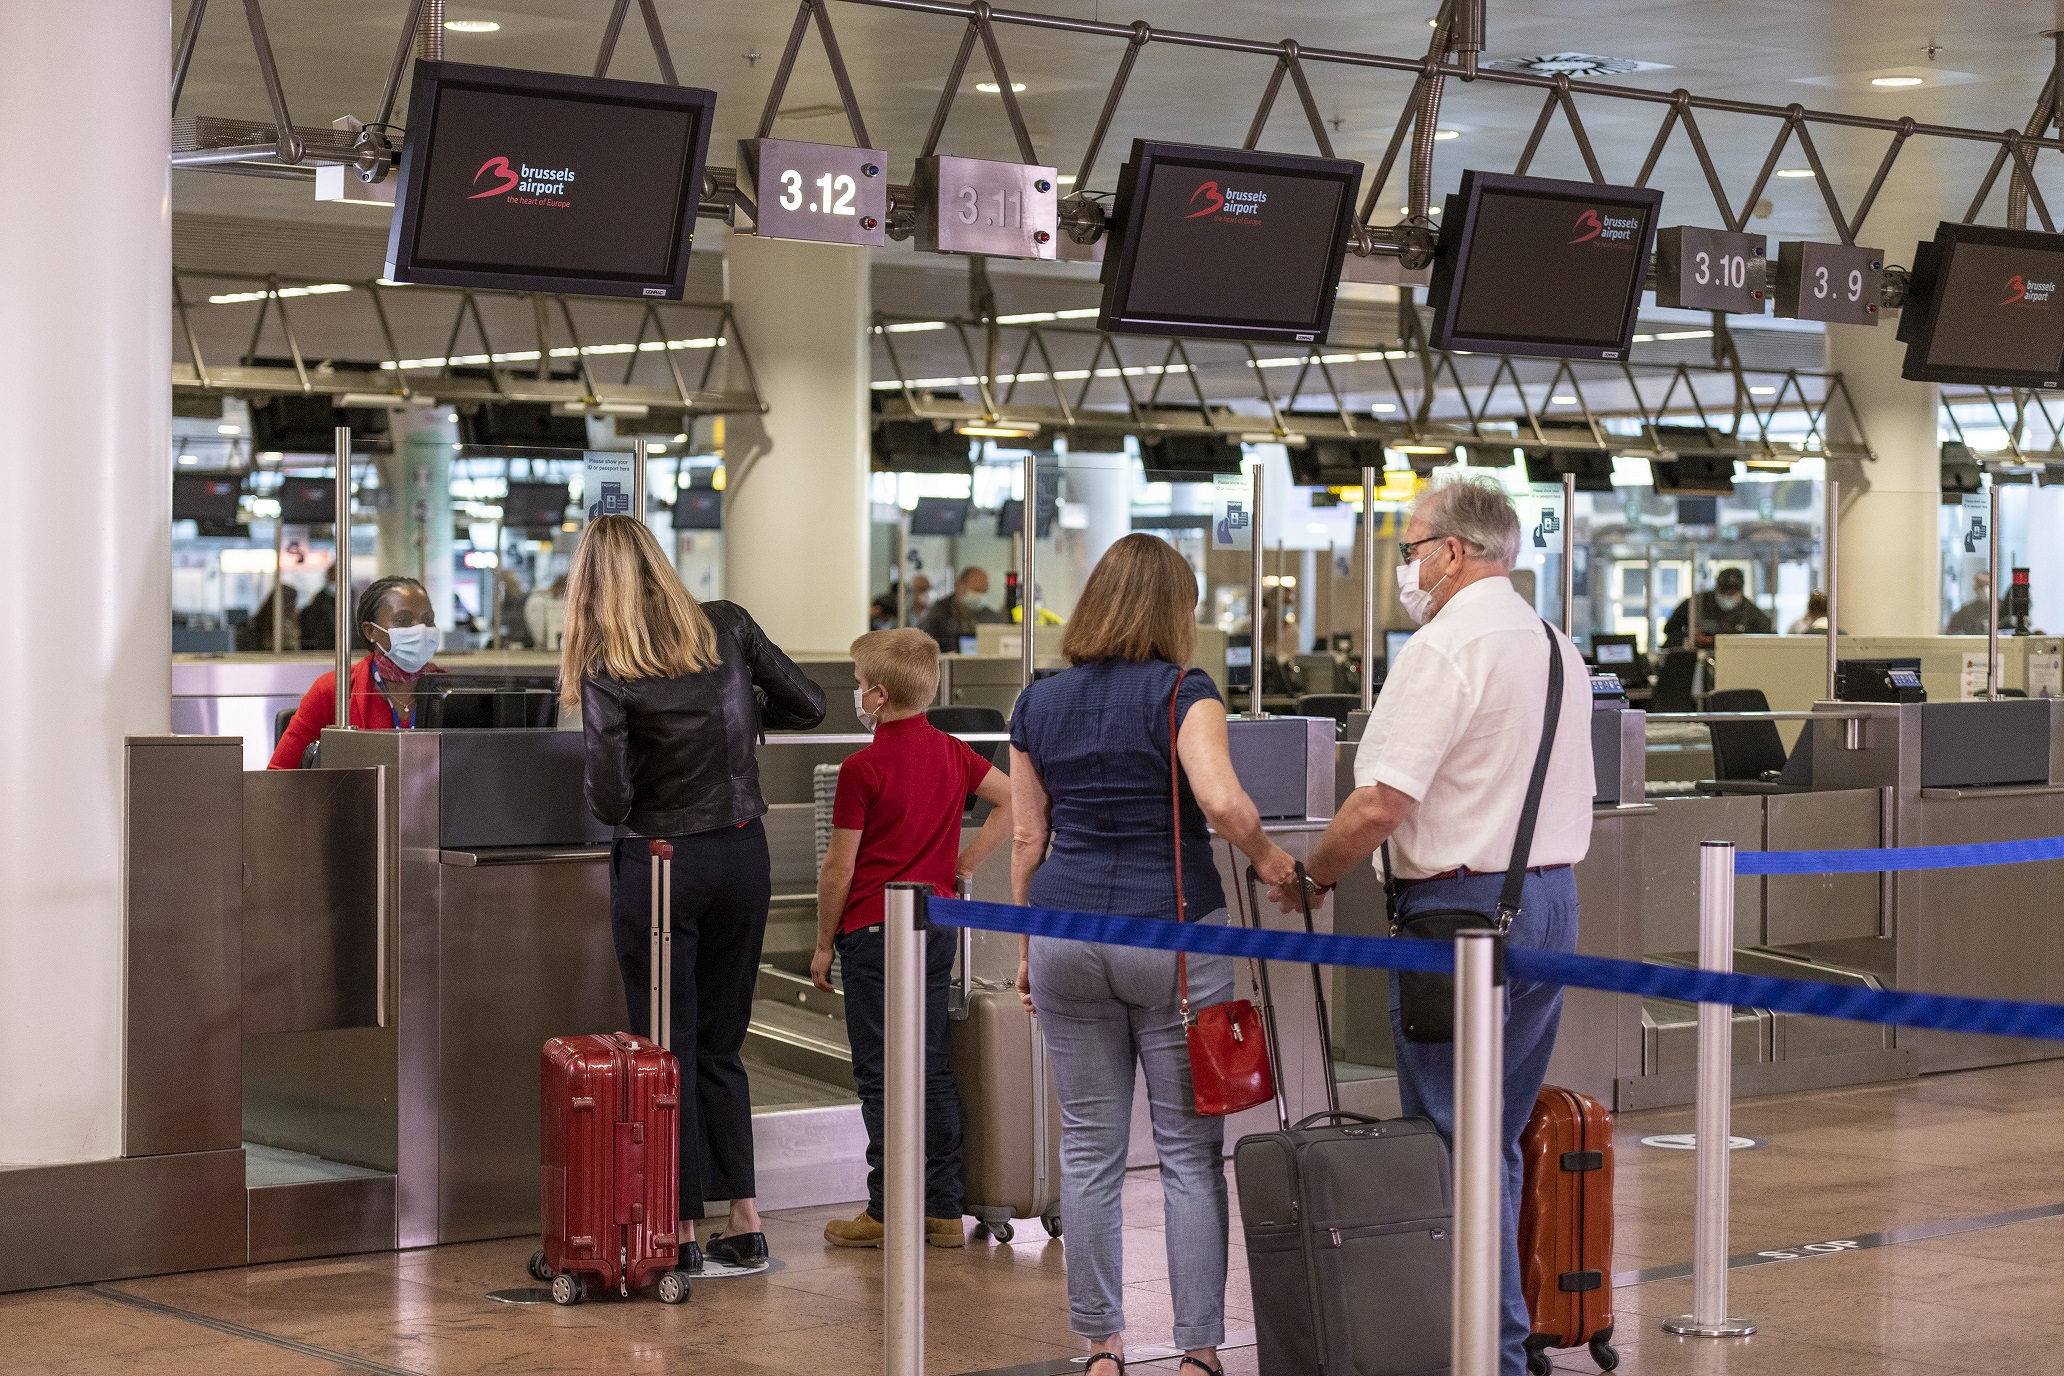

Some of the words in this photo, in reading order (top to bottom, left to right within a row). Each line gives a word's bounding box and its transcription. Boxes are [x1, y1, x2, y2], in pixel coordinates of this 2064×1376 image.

[521, 163, 575, 182] brussels
[518, 178, 565, 196] airport
[779, 169, 856, 216] 3.12
[1225, 187, 1268, 203] brussels
[507, 195, 518, 204] the
[520, 196, 538, 205] heart
[538, 197, 546, 206] of
[546, 197, 571, 209] Europe
[958, 185, 1022, 229] 3.11
[1223, 199, 1259, 216] airport
[1603, 214, 1639, 229] brussels
[1601, 226, 1631, 241] airport
[1695, 251, 1745, 289] 3.10
[2026, 279, 2056, 292] brussels
[2023, 289, 2049, 302] airport
